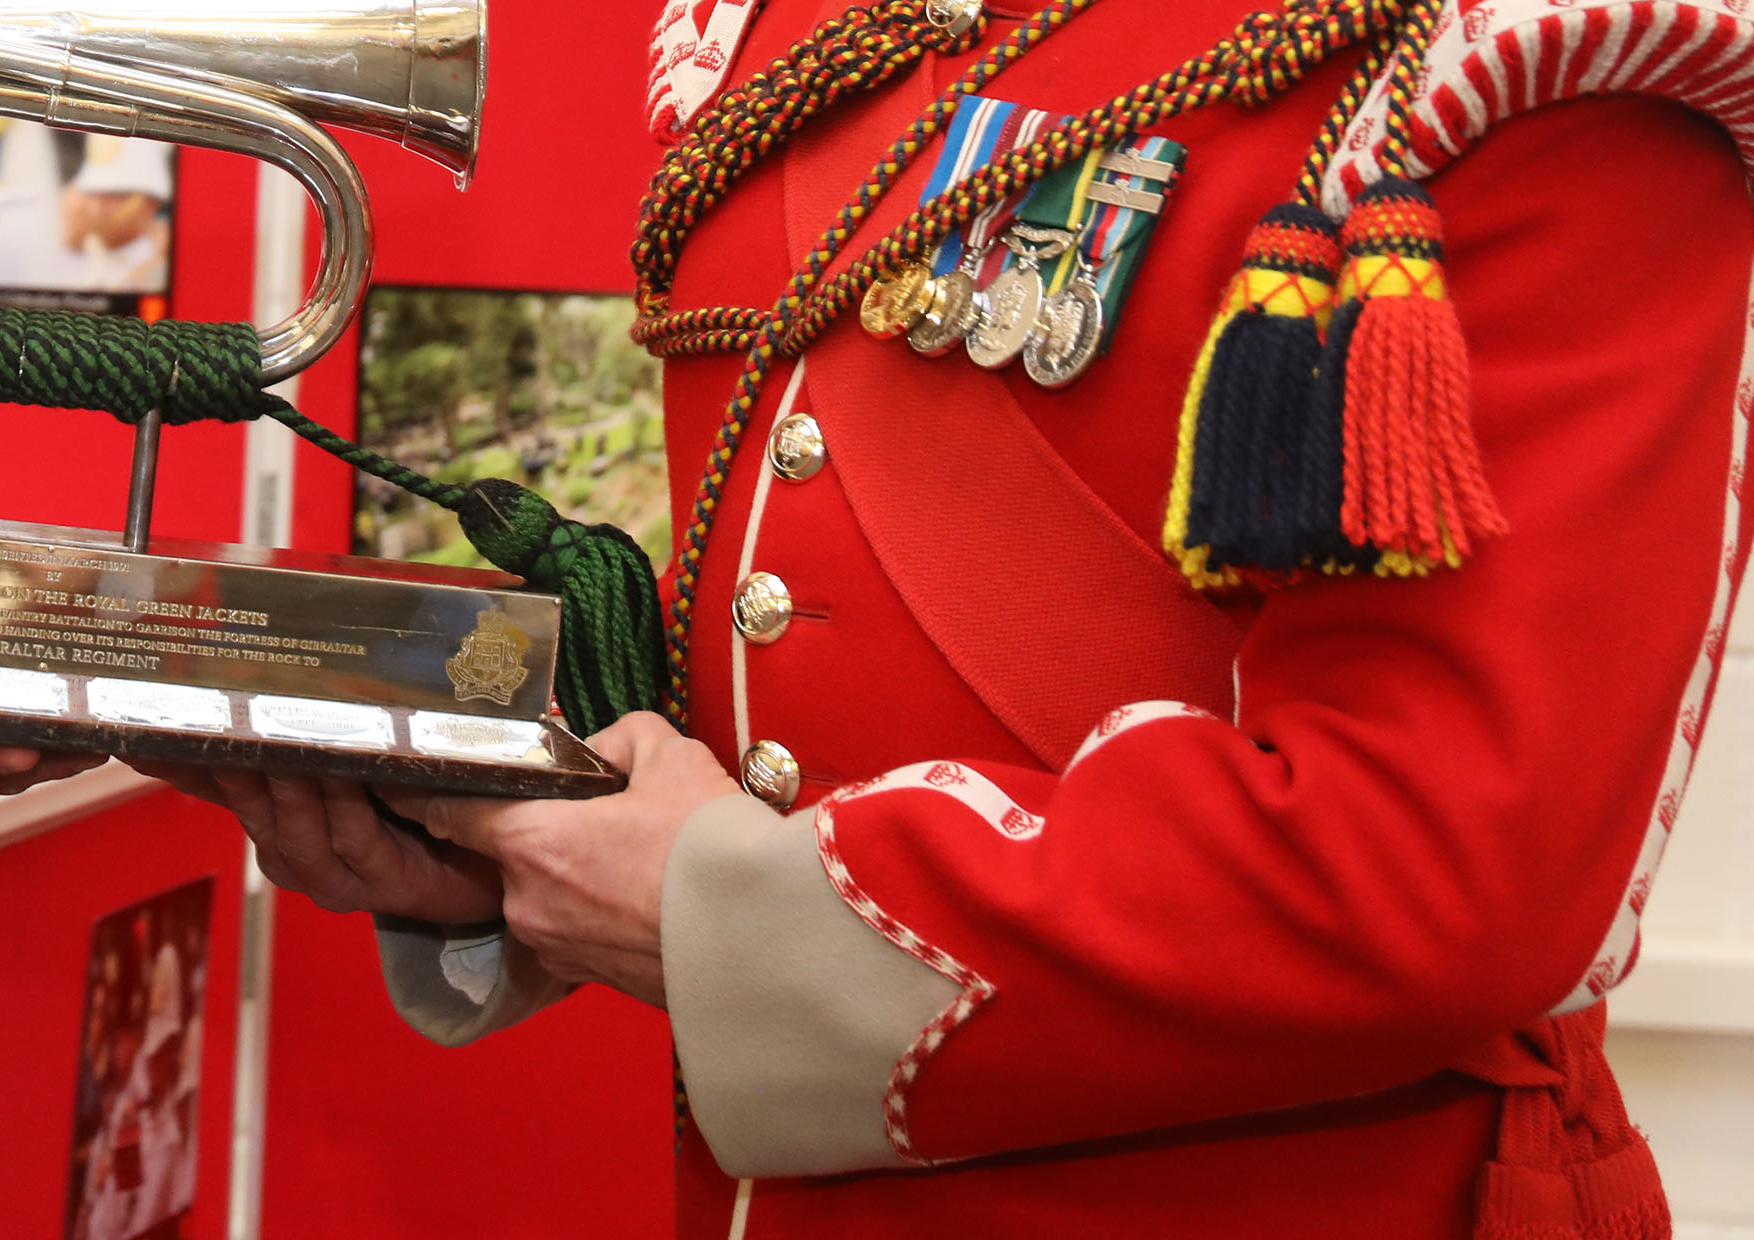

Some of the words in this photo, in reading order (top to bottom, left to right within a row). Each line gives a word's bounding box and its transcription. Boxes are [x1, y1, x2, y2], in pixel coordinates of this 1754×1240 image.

[34, 589, 68, 607] THE
[73, 593, 130, 612] ROYAL
[136, 600, 191, 619] GREEN
[196, 605, 269, 627] JACKETS
[5, 626, 60, 641] HANDING
[63, 632, 94, 644] OVER
[96, 635, 113, 646] ITS
[116, 637, 215, 657] RESPONSIBILITIES
[217, 647, 239, 658] FOR
[242, 650, 265, 662] THE
[268, 652, 300, 665] ROCK
[302, 655, 320, 667] TO
[49, 610, 115, 629] BATTALION
[117, 620, 132, 631] TO
[136, 623, 196, 638] GARRISON
[198, 629, 222, 641] THE
[224, 631, 280, 647] FORTRESS
[282, 637, 297, 649] OF
[300, 639, 366, 656] GIBRALTAR
[72, 648, 160, 670] REGIMENT
